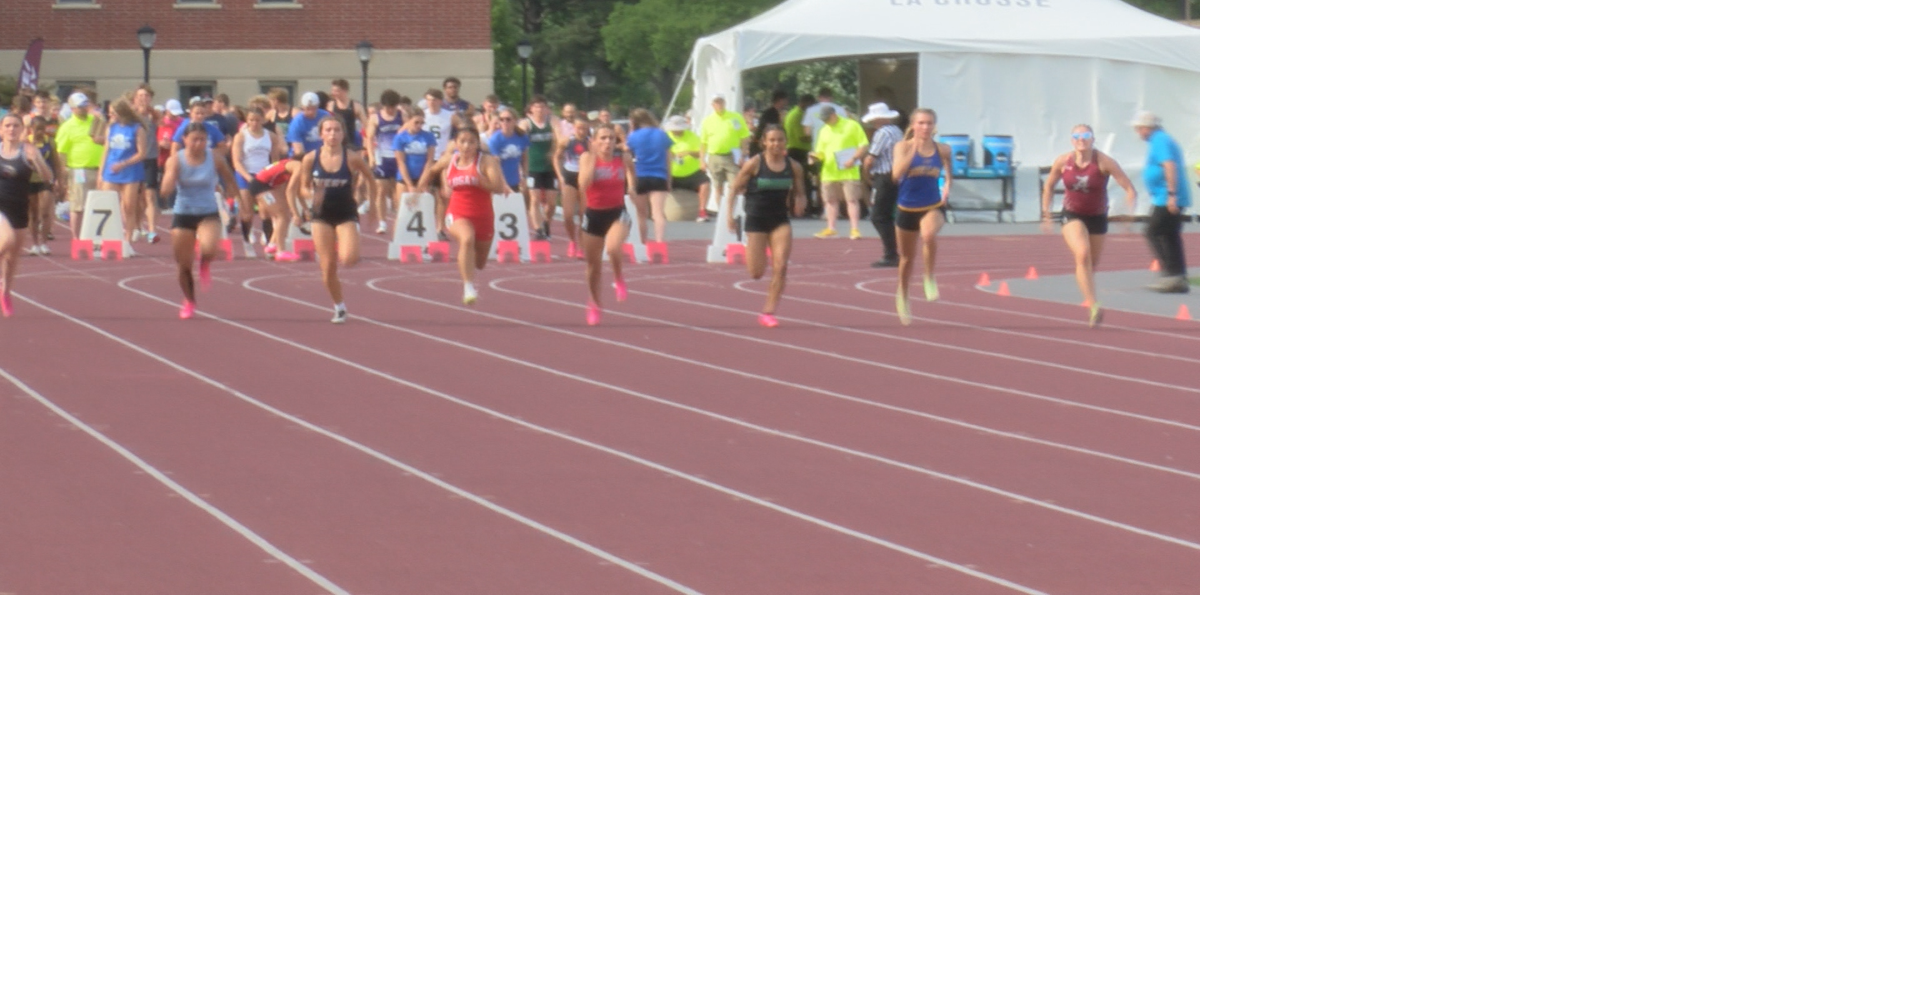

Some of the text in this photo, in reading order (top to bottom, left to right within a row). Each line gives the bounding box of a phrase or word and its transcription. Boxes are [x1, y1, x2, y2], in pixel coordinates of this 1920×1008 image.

[92, 209, 112, 236] 7
[406, 211, 426, 237] 4
[498, 213, 519, 239] 3
